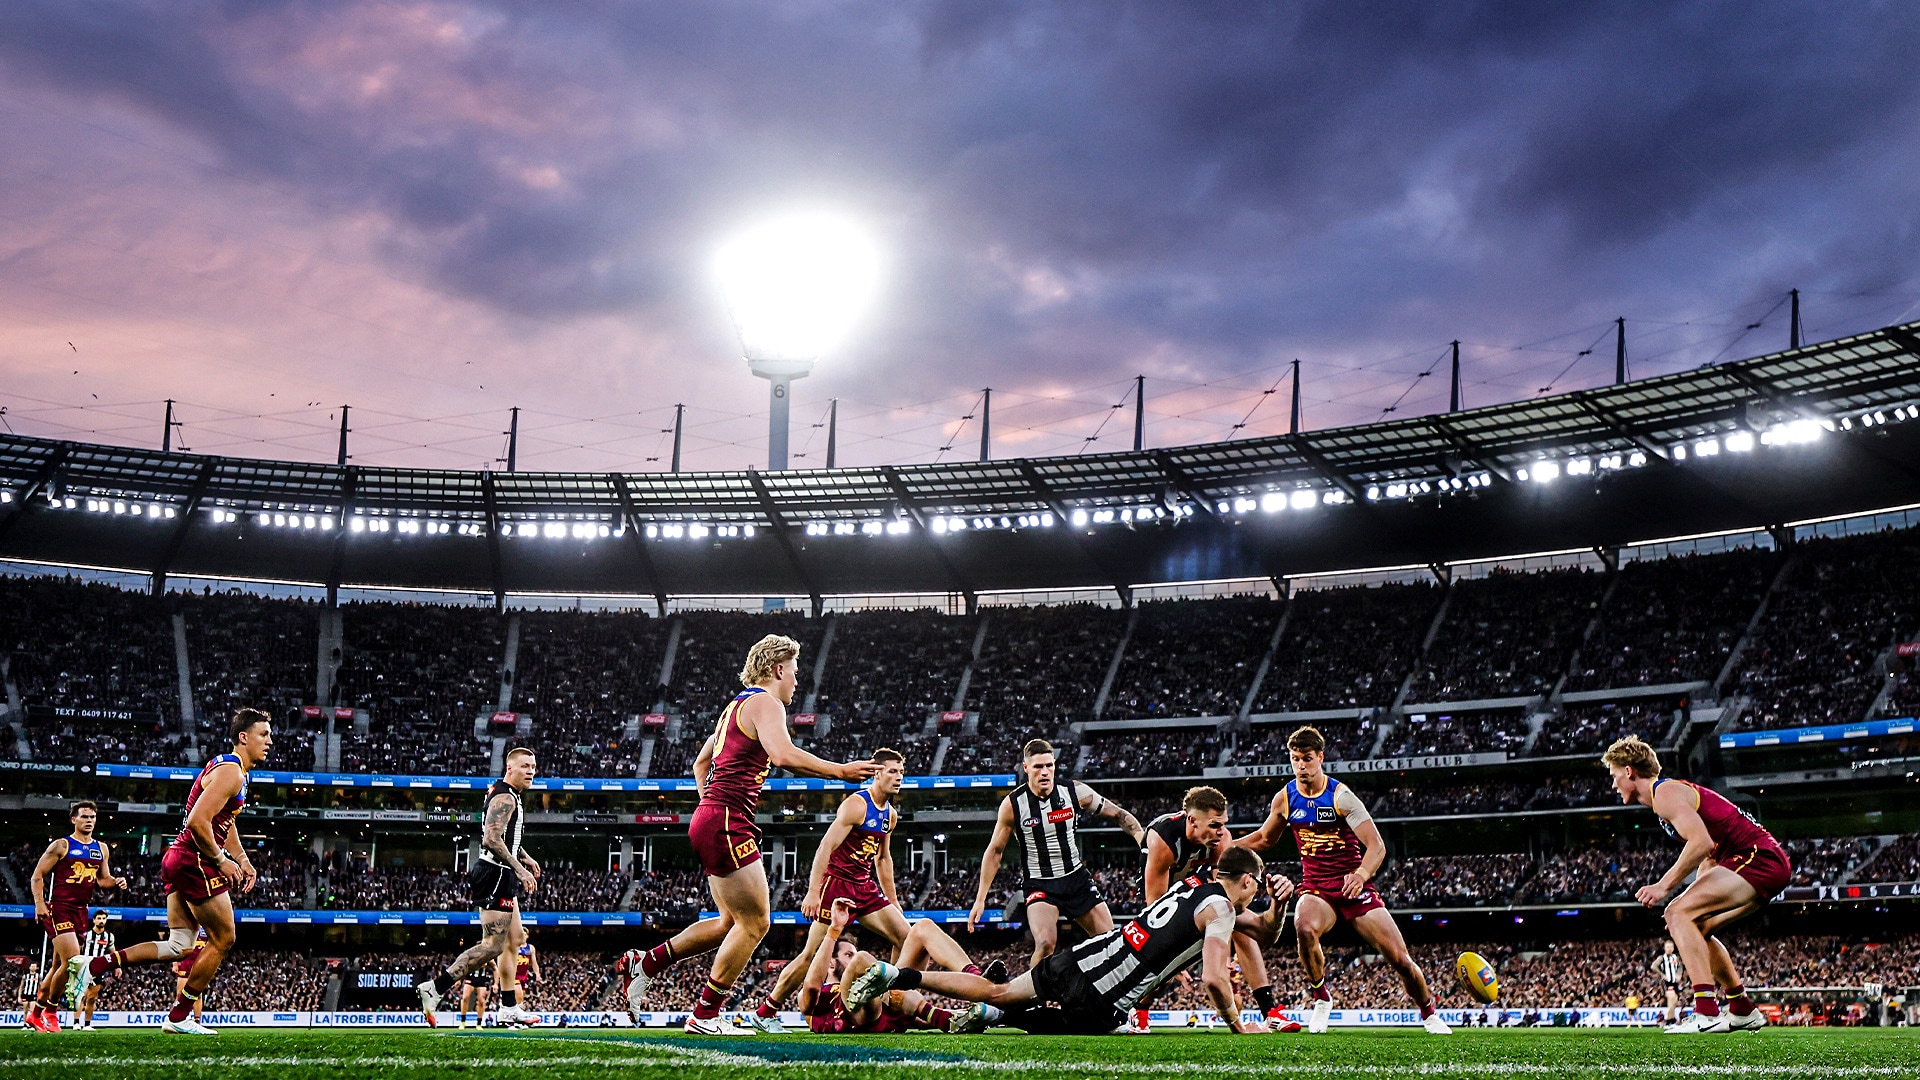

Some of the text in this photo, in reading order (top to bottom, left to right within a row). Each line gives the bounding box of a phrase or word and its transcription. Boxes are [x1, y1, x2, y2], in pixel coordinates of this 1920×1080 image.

[774, 384, 785, 398] 6
[55, 708, 75, 716] TEXT
[82, 710, 101, 718] 0409
[118, 711, 132, 719] 621
[0, 761, 75, 772] ORD STAND 2004
[1244, 756, 1463, 776] MELBONE CRICKET CLUB
[1048, 812, 1073, 821] Emirates
[1319, 809, 1333, 820] youi
[1847, 887, 1860, 898] 10
[1869, 885, 1877, 897] 5
[1892, 885, 1900, 896] 4
[357, 973, 413, 988] SIDE BY SIDE
[127, 1014, 143, 1024] LA
[192, 1014, 256, 1024] NANCIAL
[315, 1014, 438, 1024] LA TROBE FINANCI
[1359, 1013, 1374, 1022] LA
[1377, 1013, 1416, 1022] TROBE
